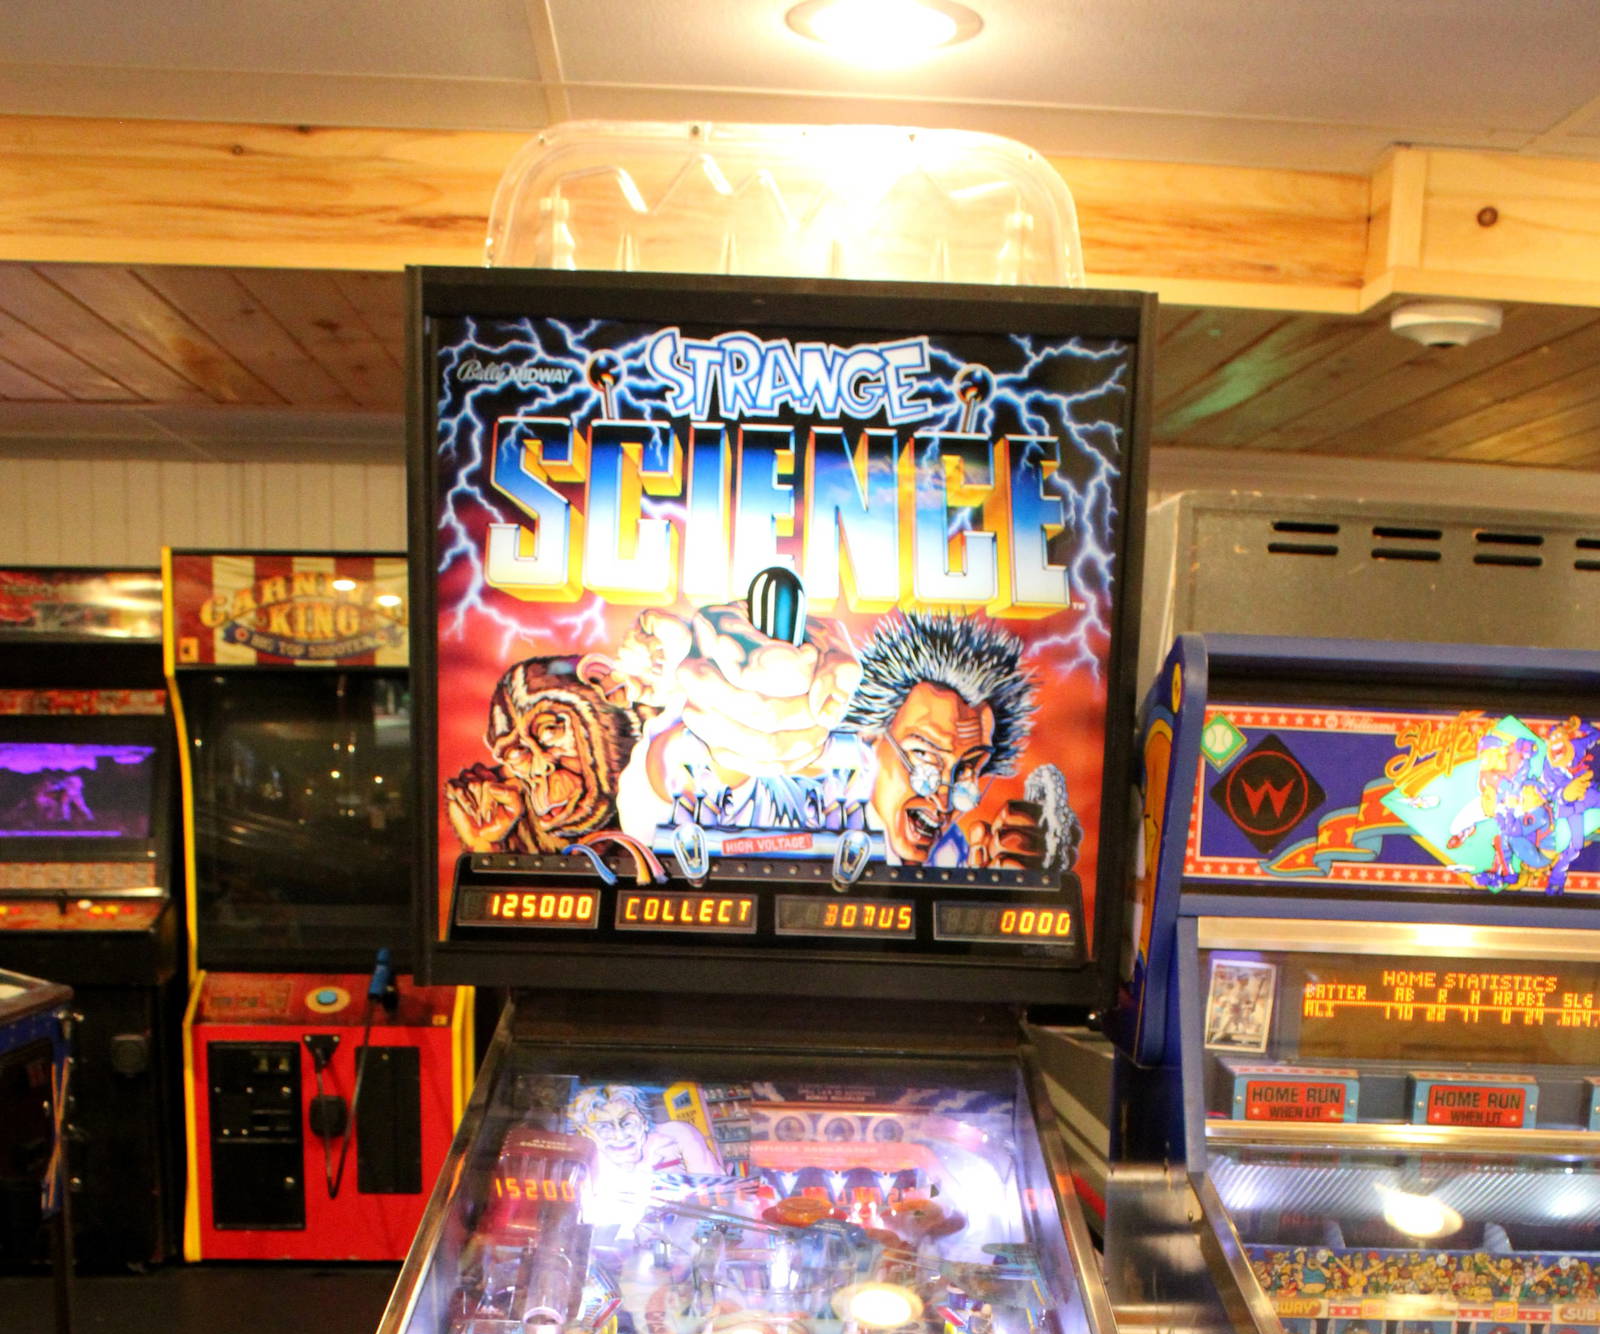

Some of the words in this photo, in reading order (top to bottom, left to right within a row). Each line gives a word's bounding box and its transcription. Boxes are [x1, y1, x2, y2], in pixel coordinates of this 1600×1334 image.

[507, 366, 573, 383] MIDWAY
[647, 327, 931, 424] STRANGE
[485, 416, 1070, 619] SCIENCE
[269, 602, 360, 640] KING
[725, 840, 754, 853] HIGH
[756, 836, 806, 850] VOLTAGE
[491, 893, 593, 919] 125000
[624, 898, 752, 923] COLLECT
[824, 903, 913, 930] BONUS
[1000, 909, 1071, 936] 0000
[1382, 970, 1437, 988] HOME
[1444, 972, 1558, 992] STATISTICS
[1304, 983, 1367, 1001] BATTER
[1562, 992, 1594, 1009] SLG
[1251, 1086, 1300, 1104] HOME
[1306, 1086, 1341, 1104] RUN
[1433, 1091, 1481, 1108] HOME
[1487, 1092, 1522, 1110] RUN
[1268, 1105, 1302, 1119] WHEN
[1450, 1110, 1483, 1123] WHEN
[1562, 1306, 1600, 1321] SUB
